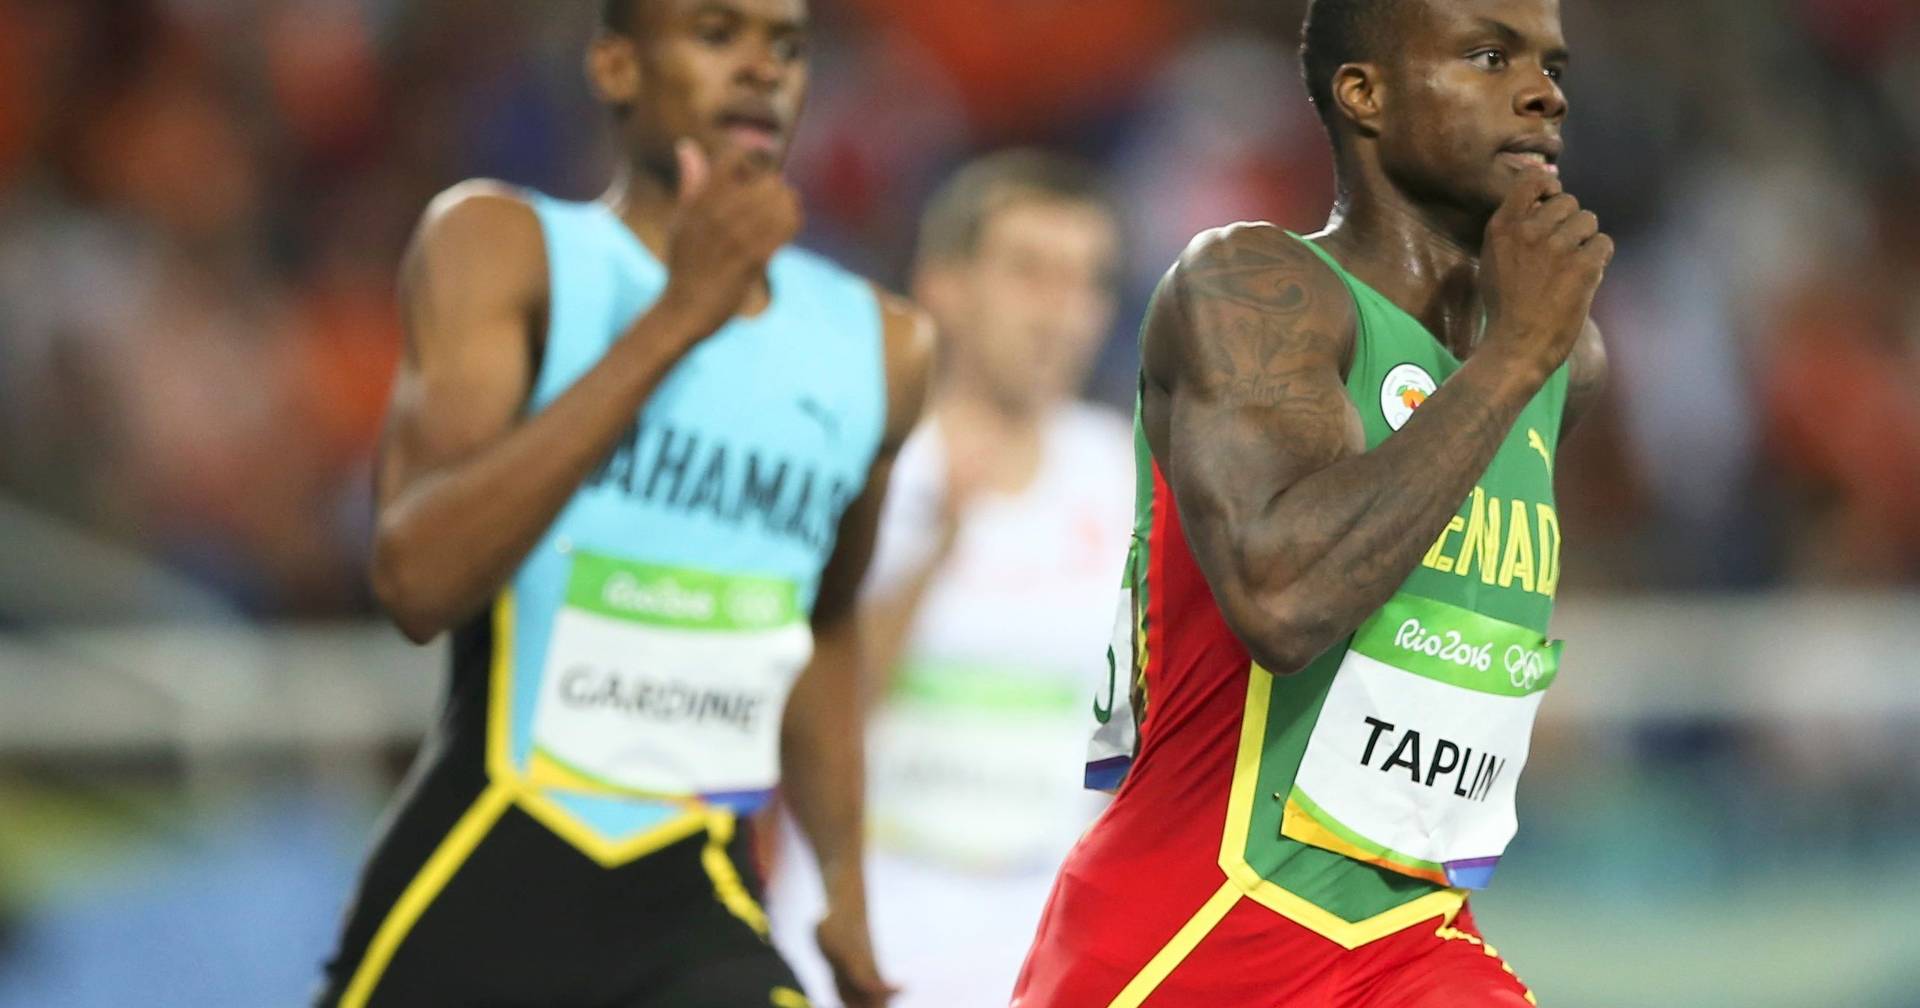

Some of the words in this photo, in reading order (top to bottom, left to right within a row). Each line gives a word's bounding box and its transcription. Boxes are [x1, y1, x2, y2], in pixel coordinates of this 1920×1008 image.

[582, 424, 857, 547] AHAMAS
[1422, 485, 1561, 597] ENAD
[1394, 618, 1493, 672] Rio2016
[1360, 716, 1506, 802] TAPLIN
